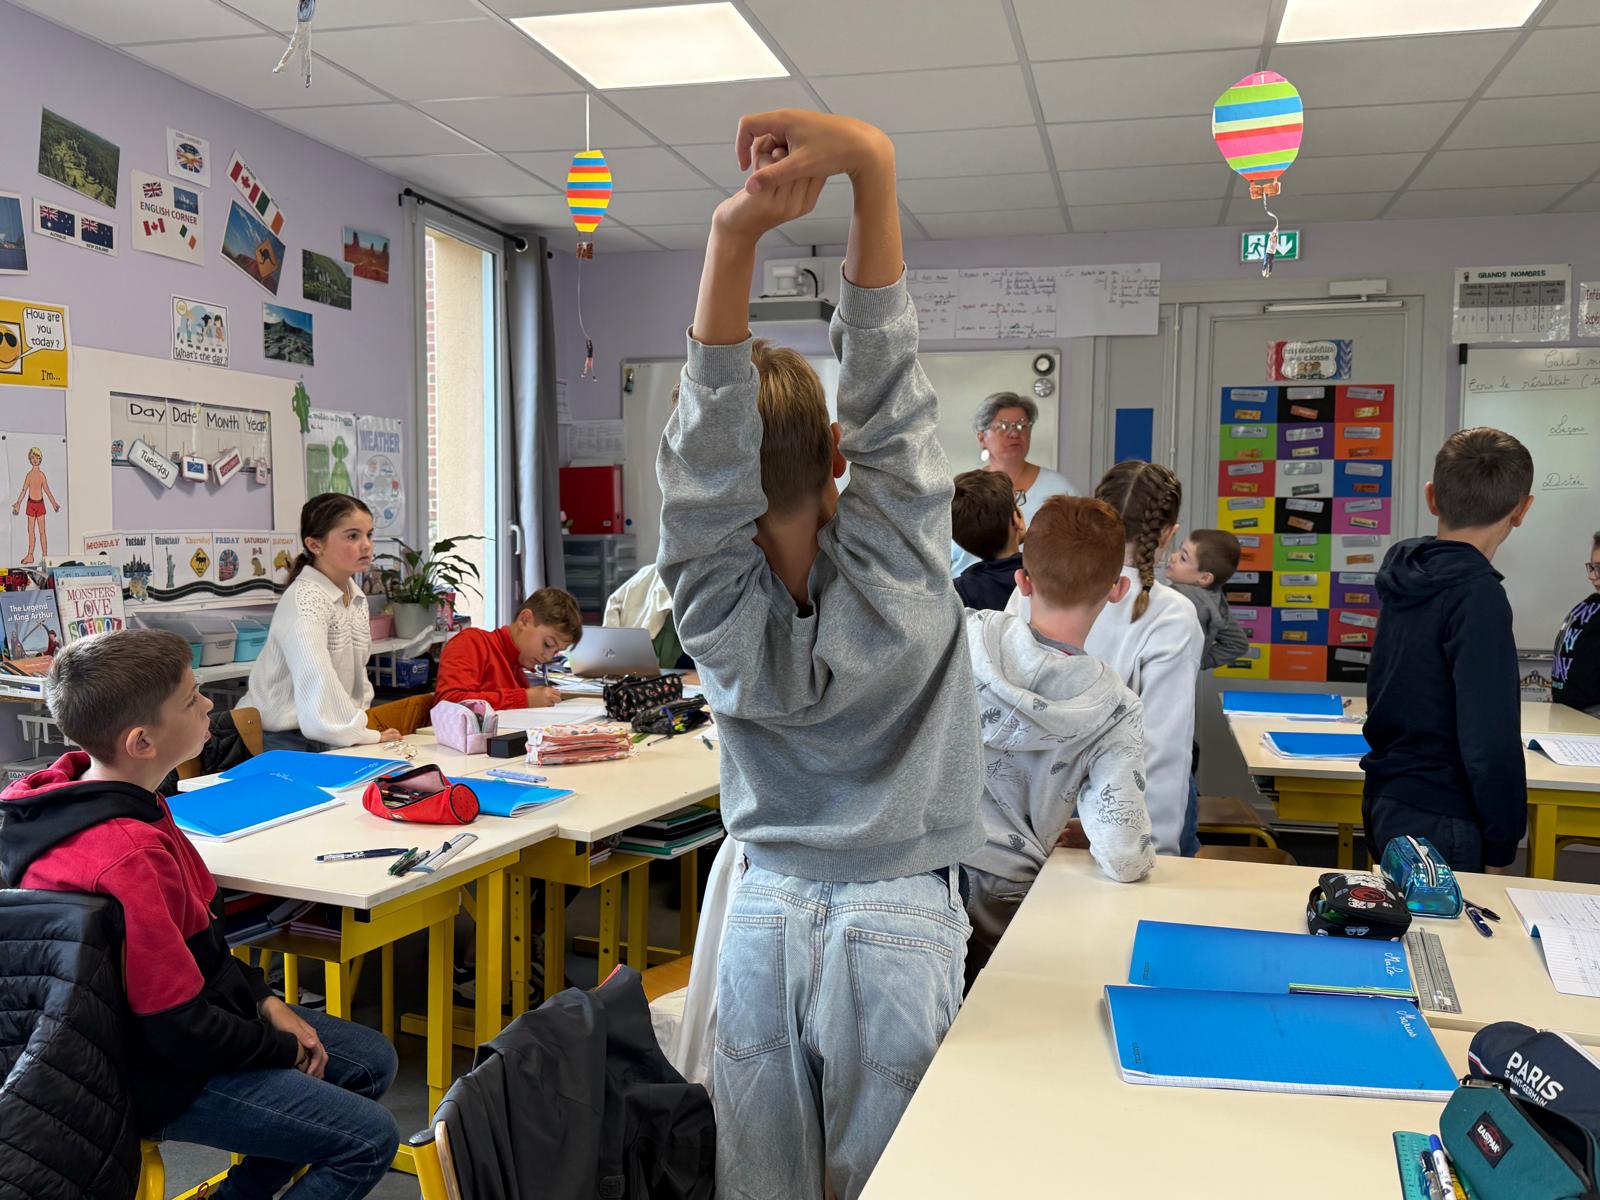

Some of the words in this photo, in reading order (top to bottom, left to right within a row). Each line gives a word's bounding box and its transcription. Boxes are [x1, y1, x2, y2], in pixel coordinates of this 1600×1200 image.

[140, 201, 170, 217] ENGLISH
[171, 210, 197, 225] CORNER
[26, 309, 45, 320] How
[47, 312, 60, 322] are
[37, 325, 51, 334] you
[31, 337, 54, 348] today
[175, 347, 198, 360] What's
[199, 352, 211, 361] the
[212, 354, 223, 365] day
[130, 403, 166, 422] Day
[172, 406, 198, 424] Date
[360, 430, 400, 454] WEATHER
[140, 449, 170, 480] Tuesday
[86, 538, 120, 550] MONDAY
[125, 536, 146, 546] TUESDAY
[67, 586, 116, 601] MONSTERS
[9, 605, 21, 613] The
[22, 602, 48, 612] Legend
[14, 613, 29, 622] King
[31, 611, 54, 620] Arthur
[73, 598, 113, 618] LOVE
[1396, 1010, 1417, 1038] Marius
[1506, 1051, 1564, 1101] PARIS
[1503, 1069, 1548, 1107] SAINT-GERMAIN
[1477, 1124, 1500, 1153] EASTPAK
